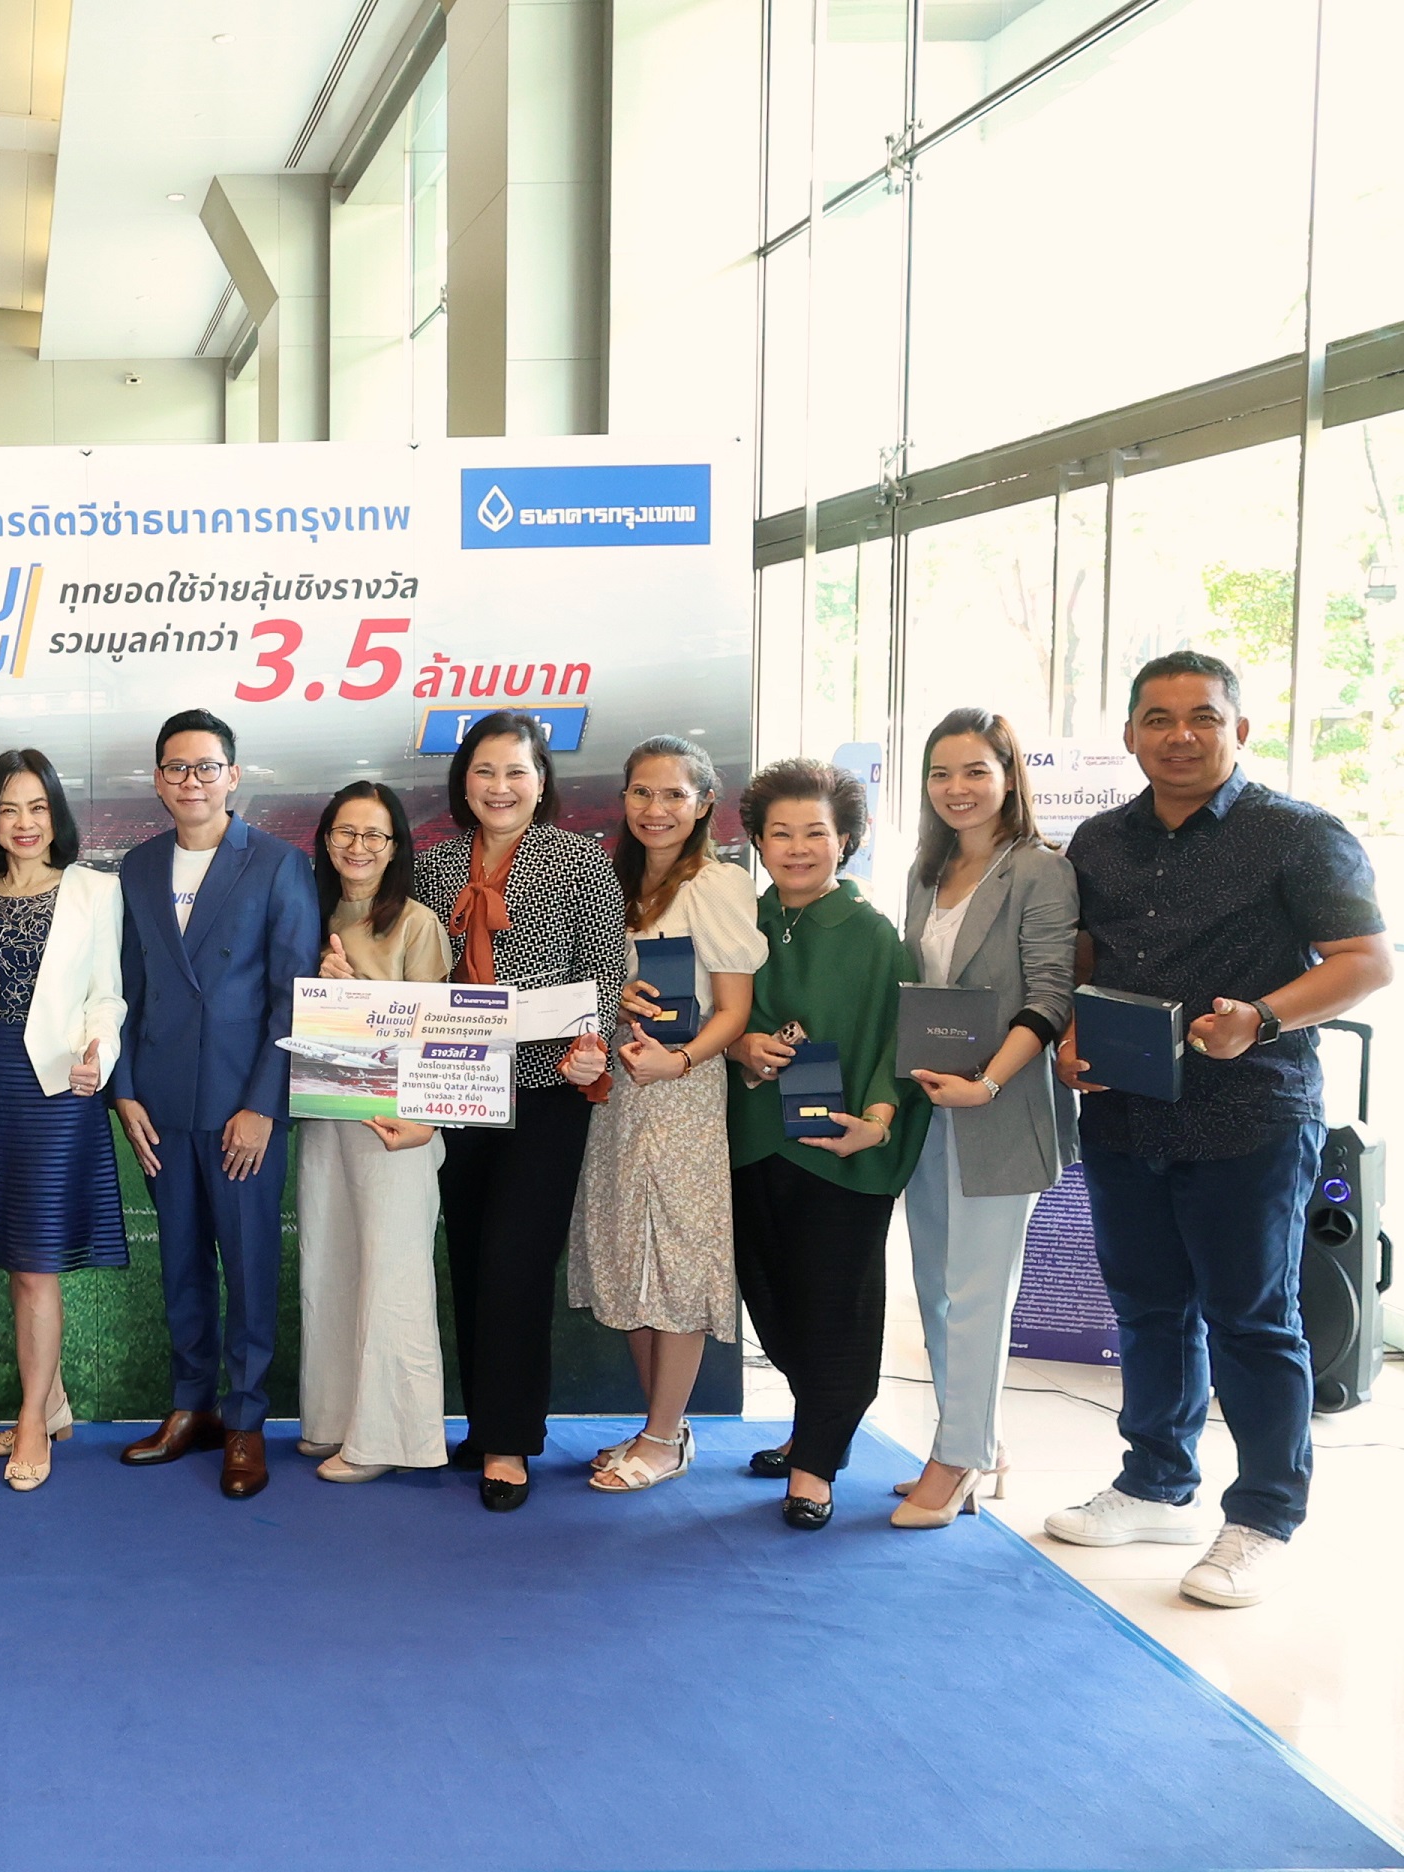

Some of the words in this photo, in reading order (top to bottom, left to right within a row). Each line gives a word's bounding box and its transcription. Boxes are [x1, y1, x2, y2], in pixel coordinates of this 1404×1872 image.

[520, 505, 696, 530] ธนาคารกรุงเทพ
[59, 570, 419, 613] ทุกยอดใช้จ่ายลุ้นชิงรางวัล
[48, 622, 239, 662] รวมมูลค่ากว่า
[234, 617, 412, 703] 3.5
[412, 652, 592, 698] ล้านบาท
[1023, 753, 1055, 767] ISA
[172, 893, 195, 904] VIS
[300, 987, 327, 998] VISA
[388, 1001, 417, 1014] ช้อป
[468, 1049, 477, 1059] 2
[444, 1083, 468, 1091] Qatar
[470, 1084, 506, 1094] Airways
[425, 1102, 487, 1117] 440,970
